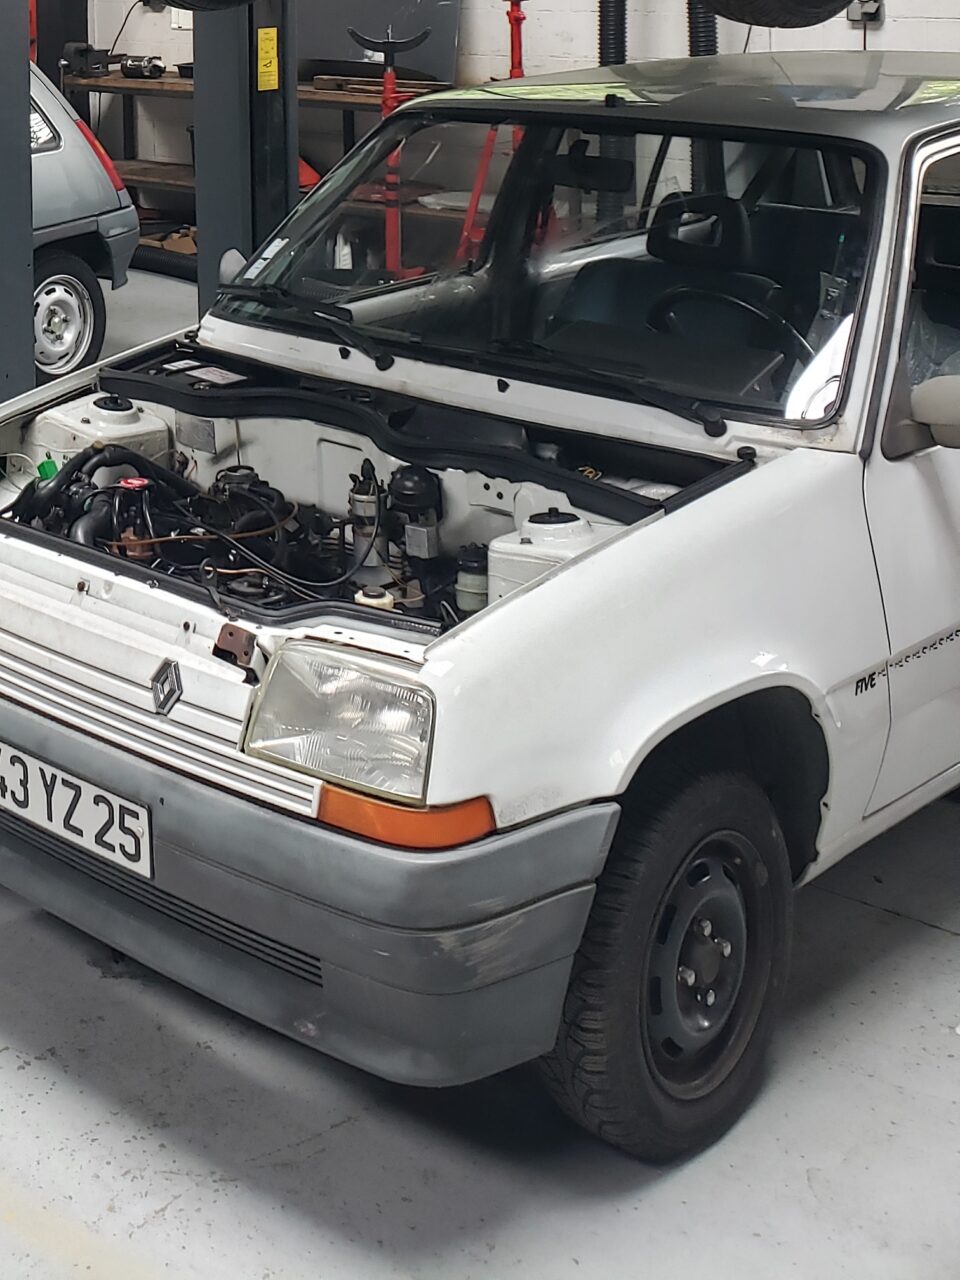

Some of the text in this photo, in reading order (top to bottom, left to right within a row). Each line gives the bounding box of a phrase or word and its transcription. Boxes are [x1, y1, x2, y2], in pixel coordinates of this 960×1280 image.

[855, 672, 877, 696] FIVE
[39, 766, 84, 838] YZ
[93, 794, 141, 863] 25
